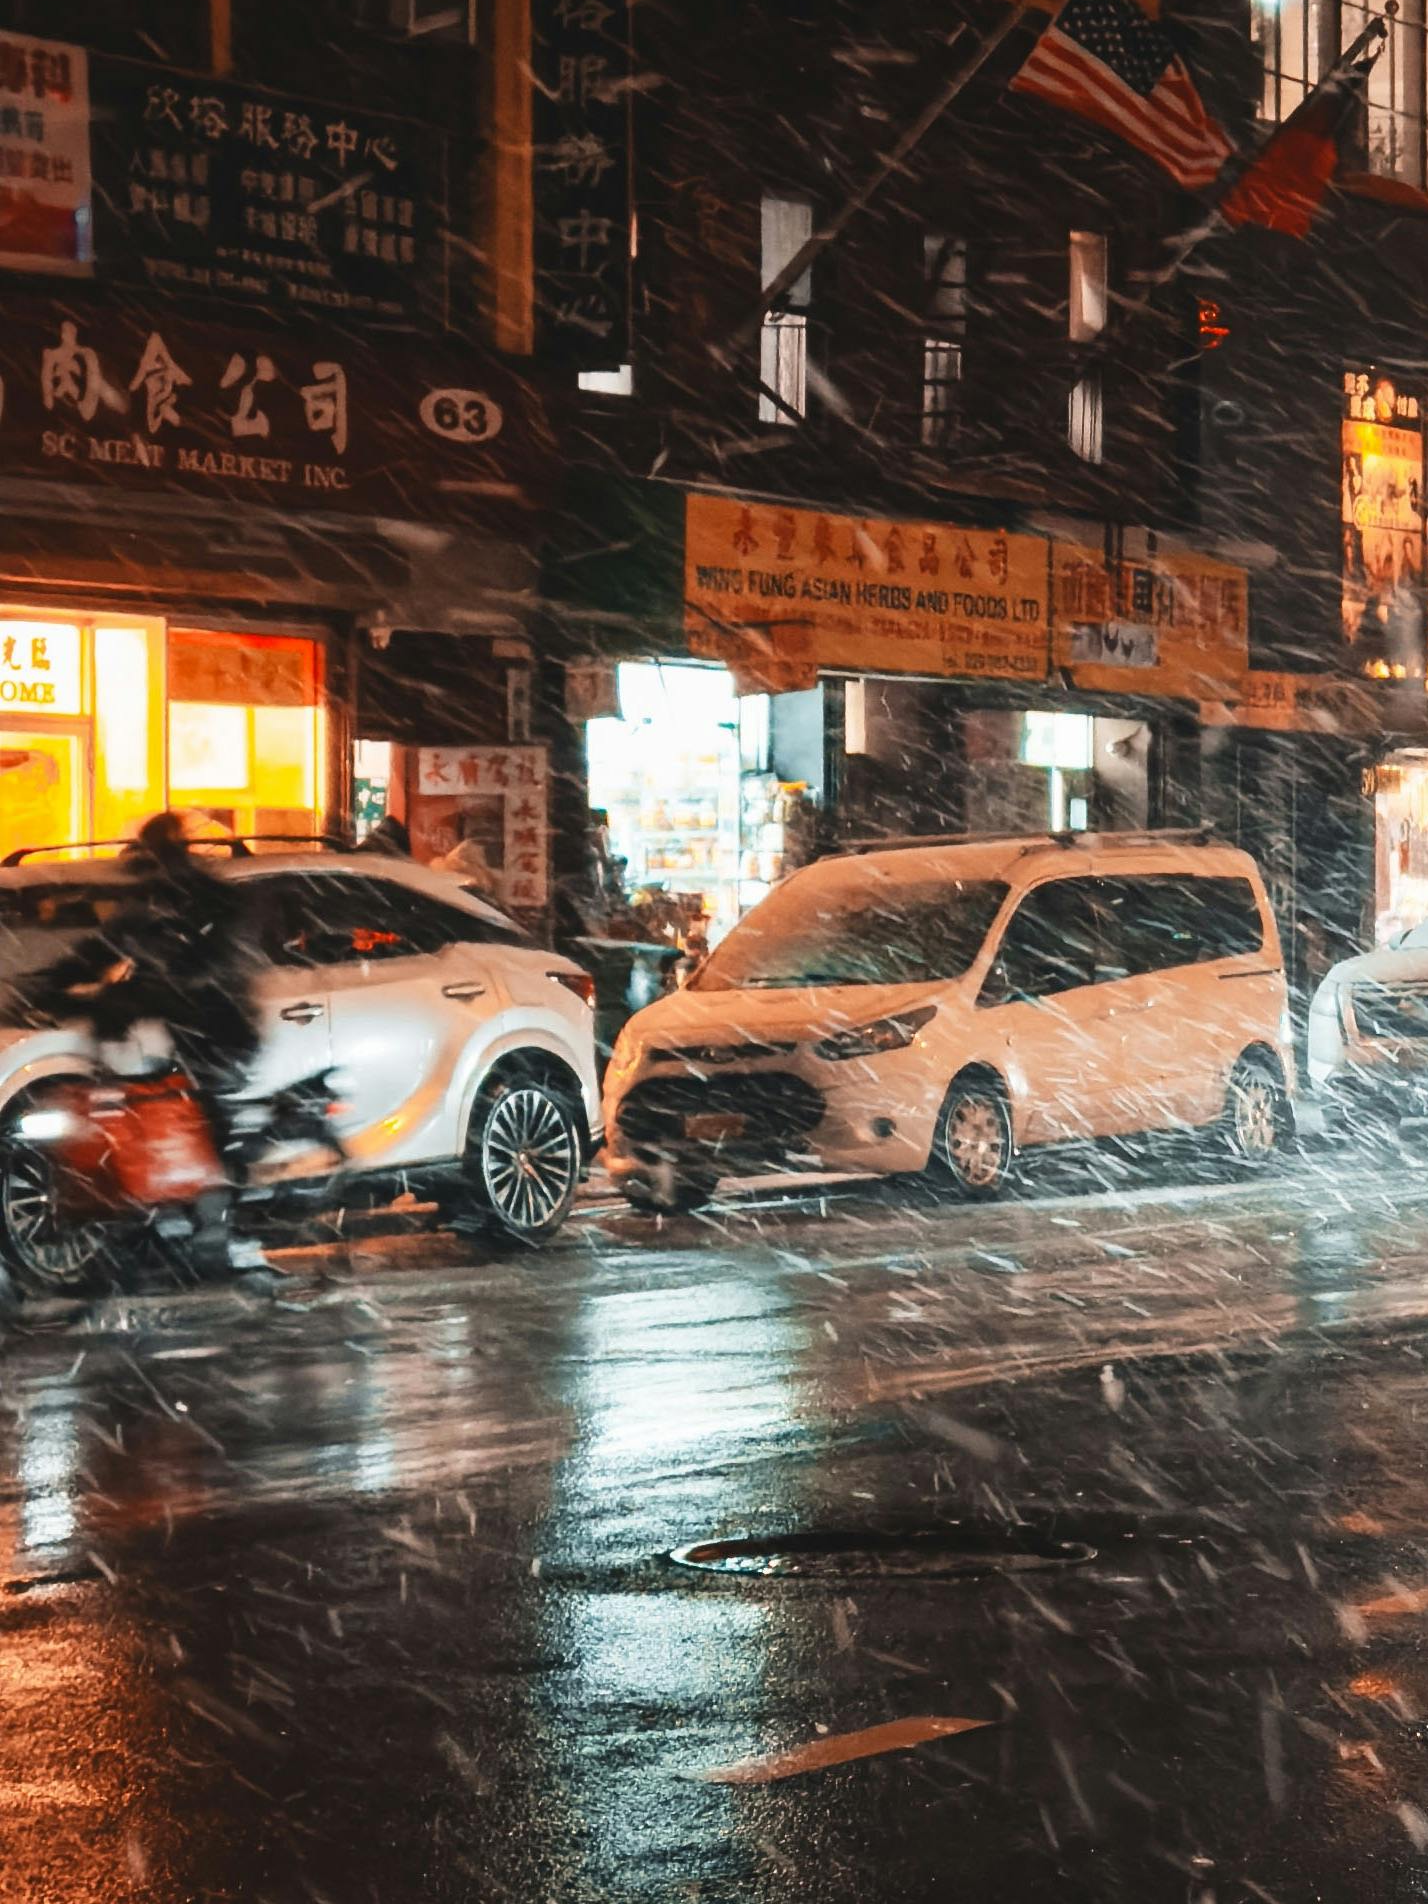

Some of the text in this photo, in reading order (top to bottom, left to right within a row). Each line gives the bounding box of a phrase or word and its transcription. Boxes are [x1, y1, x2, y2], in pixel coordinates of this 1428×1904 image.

[433, 396, 489, 435] 63
[88, 434, 165, 468] MEAT
[177, 447, 293, 483] MARKET
[747, 568, 798, 600] FUNG
[799, 576, 852, 606] ASIAN
[855, 581, 912, 611] HERBS
[914, 590, 949, 616] AND
[951, 592, 1009, 620] FOODS
[1010, 597, 1041, 624] LTD
